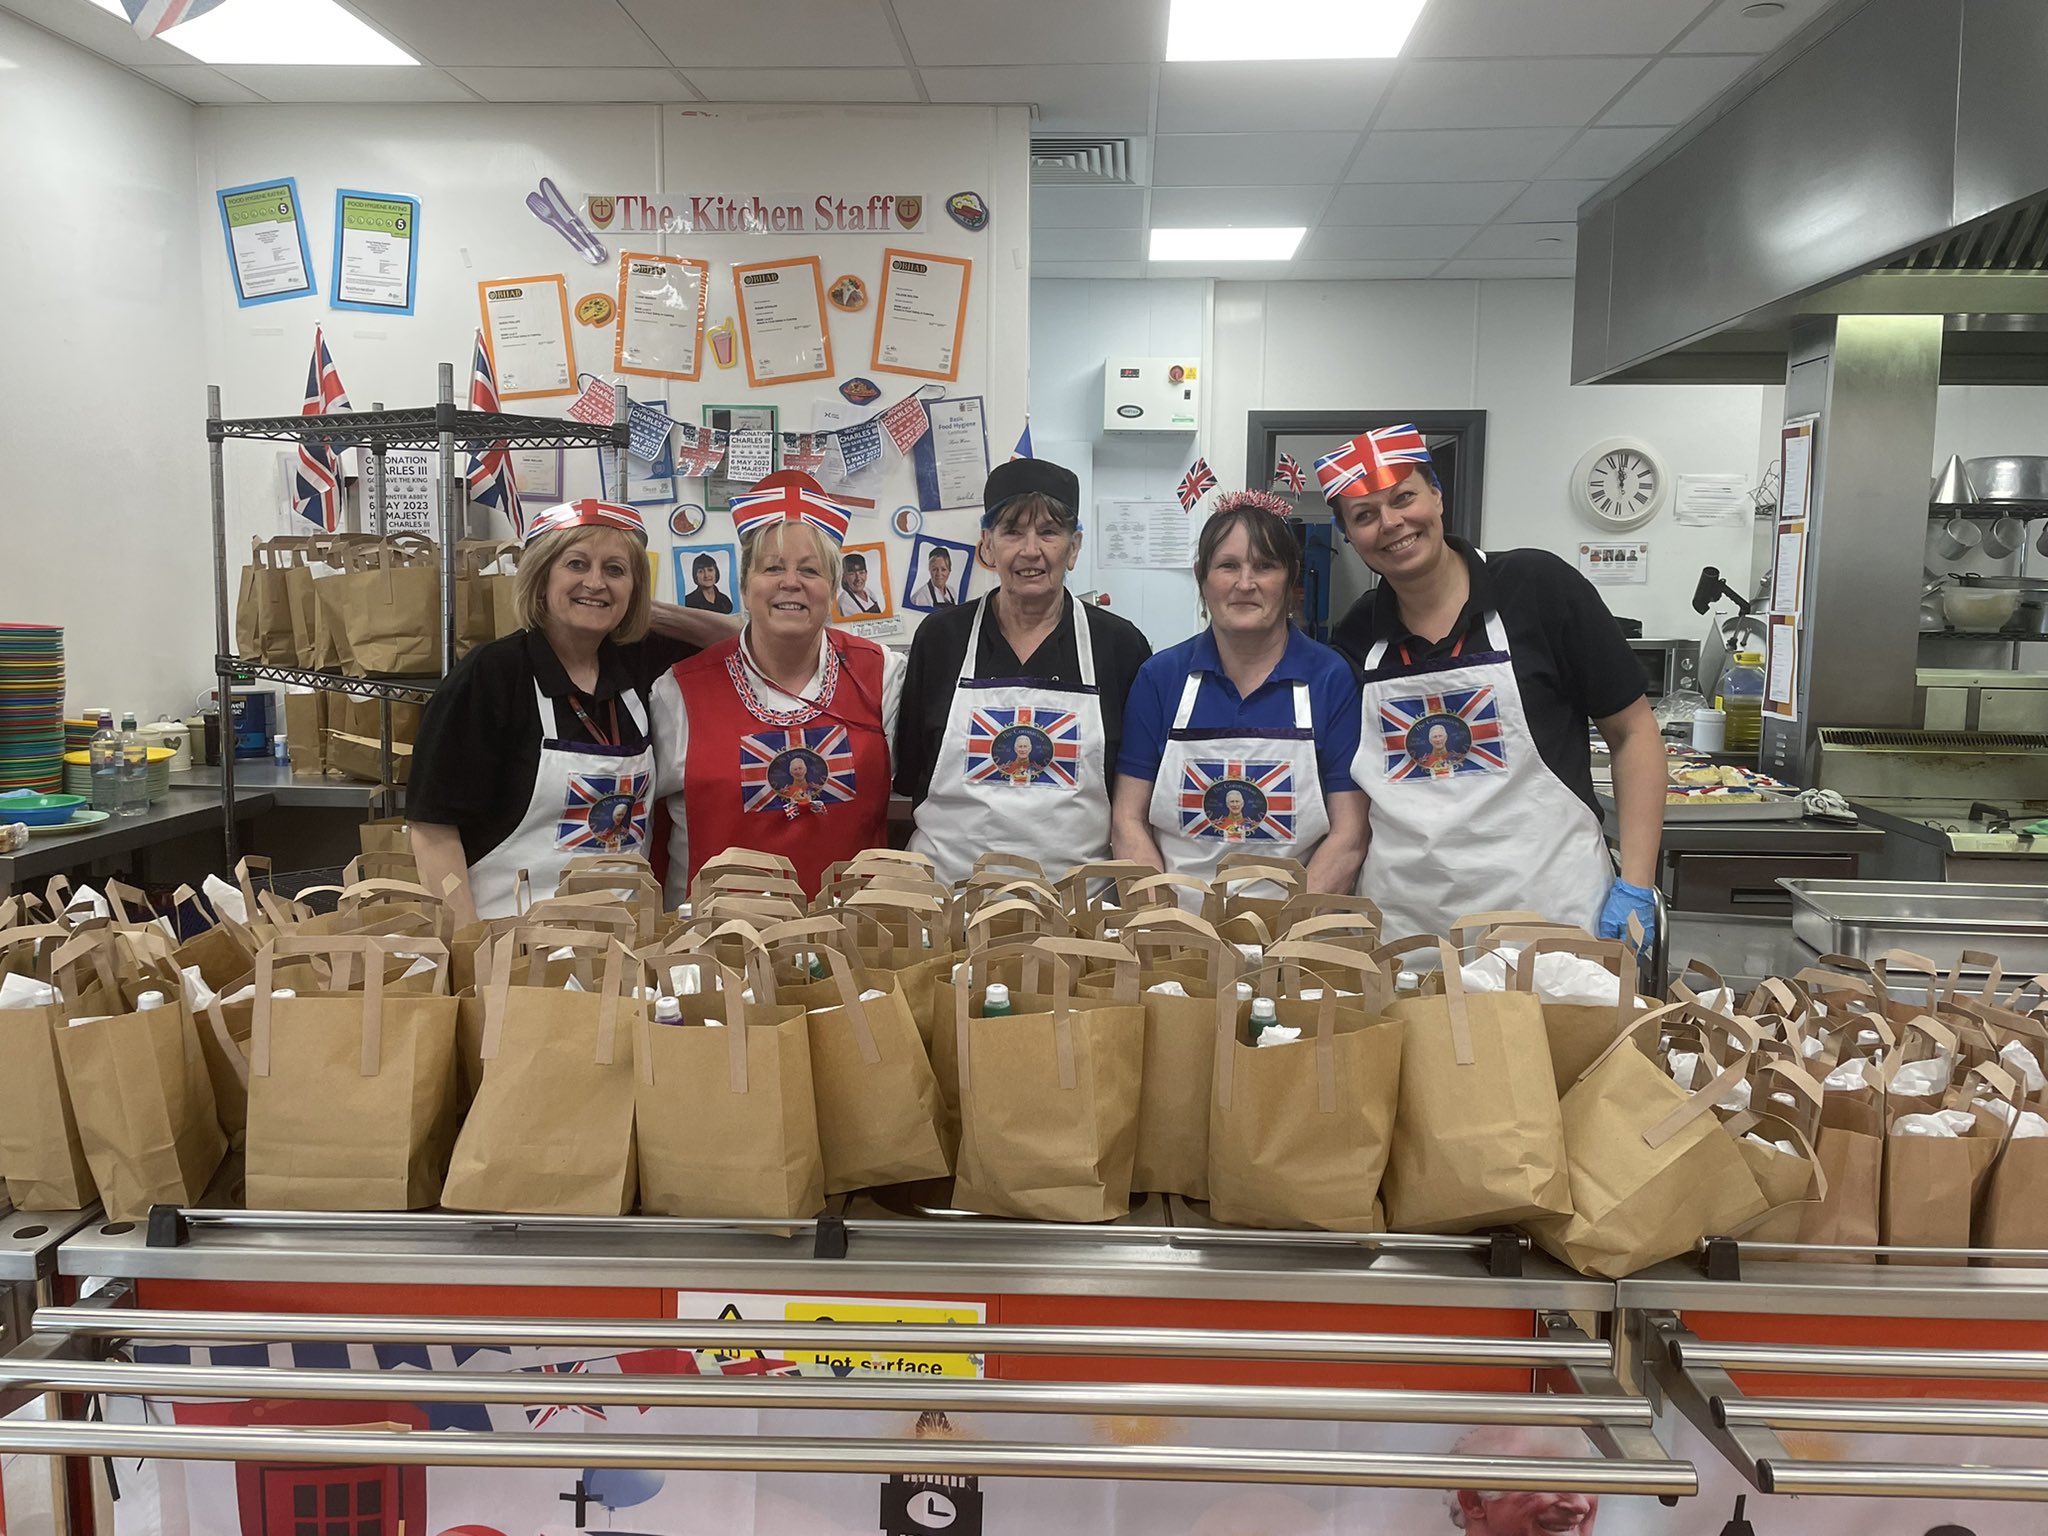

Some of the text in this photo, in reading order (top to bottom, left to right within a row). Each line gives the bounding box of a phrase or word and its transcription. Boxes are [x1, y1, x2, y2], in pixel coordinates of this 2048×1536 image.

[228, 196, 244, 204] FOOD
[364, 202, 388, 210] HYGIENE
[388, 204, 407, 212] RATING
[616, 195, 894, 232] The Kitchen Staff
[632, 410, 663, 429] CHARLES
[884, 405, 913, 426] CHARLES
[630, 434, 658, 450] MAY 2023
[840, 430, 871, 443] CHARLES
[901, 430, 914, 442] MAY
[631, 441, 656, 455] MAJESTY
[366, 456, 427, 464] CONATION
[851, 454, 865, 462] MAY
[366, 466, 427, 475] CARLES III
[369, 502, 429, 510] 6 AY 2023
[386, 512, 429, 520] MAJESTY
[815, 1354, 943, 1376] Hot surface
